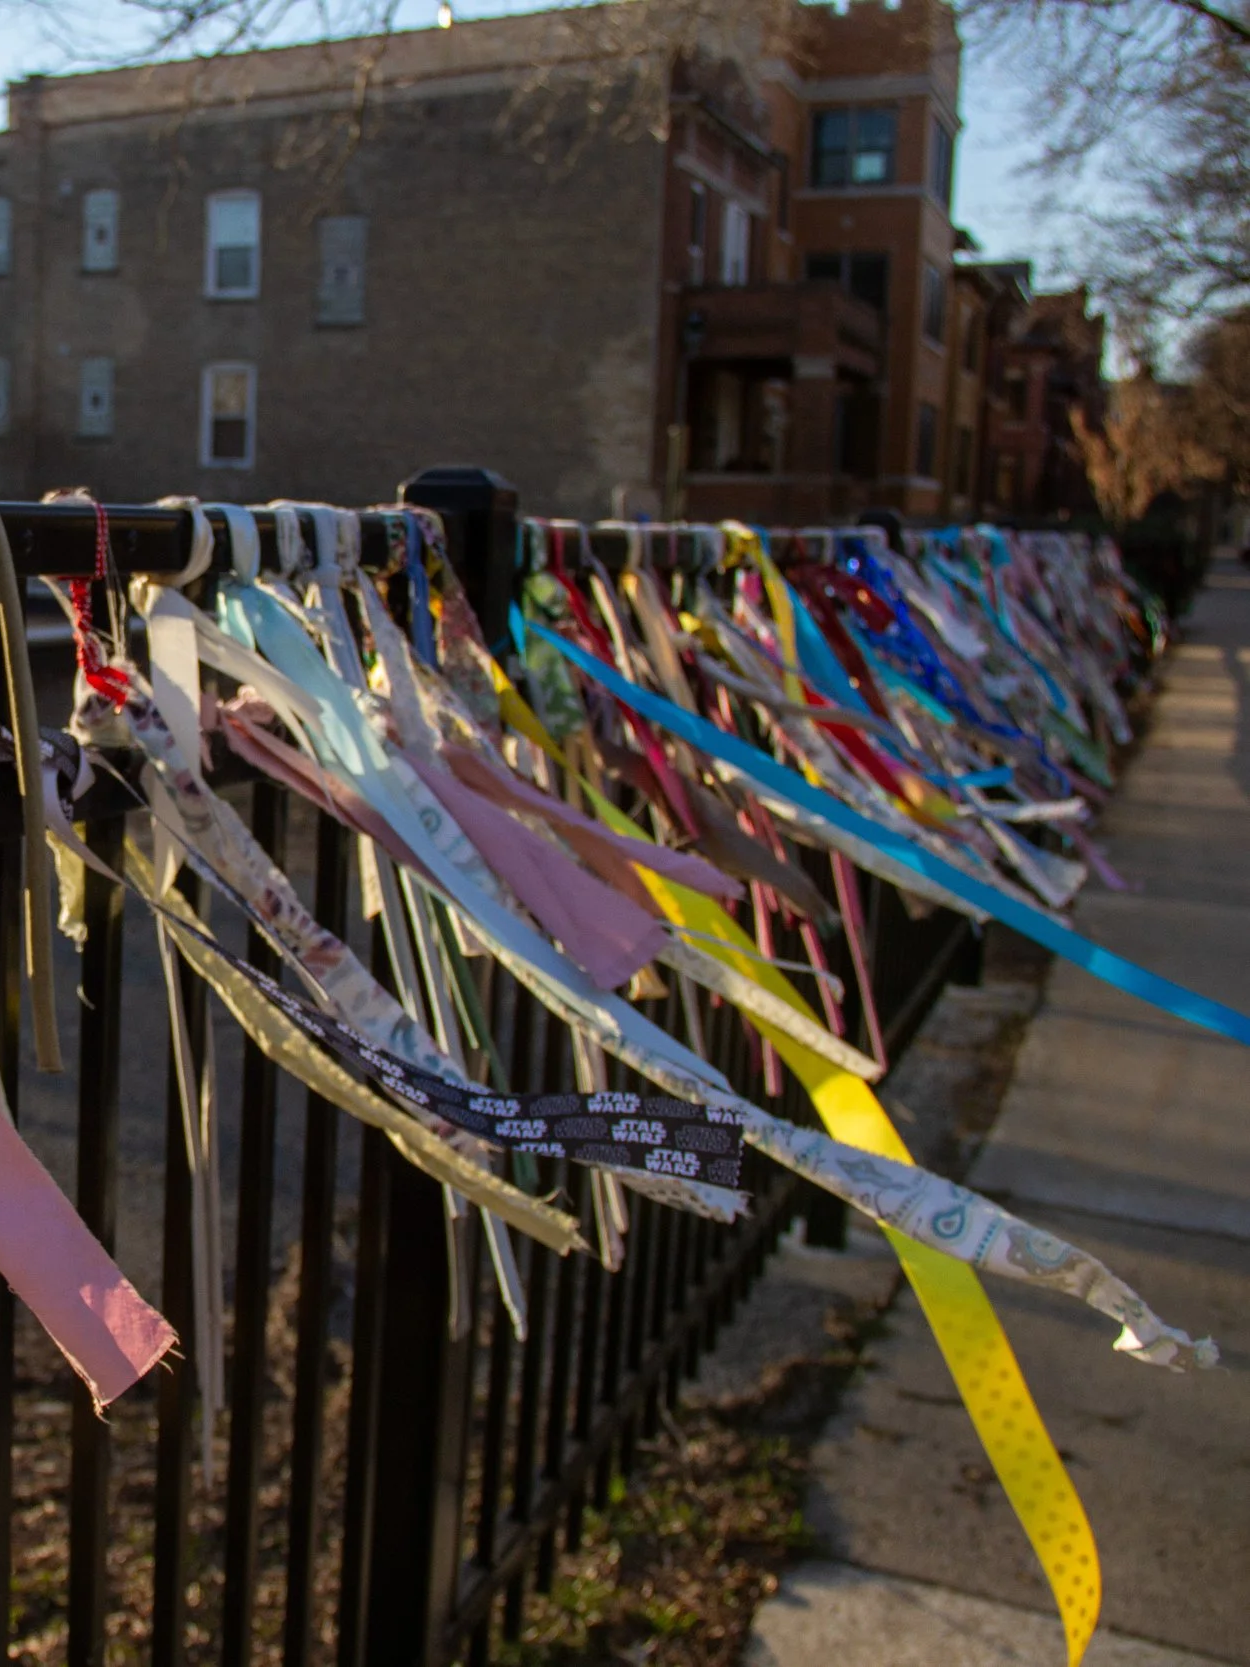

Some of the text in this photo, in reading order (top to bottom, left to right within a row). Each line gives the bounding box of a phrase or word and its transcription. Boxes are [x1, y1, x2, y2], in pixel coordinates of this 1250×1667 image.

[588, 1091, 639, 1103] STAR
[587, 1101, 641, 1114] WARS
[496, 1119, 546, 1130] STAR
[612, 1119, 664, 1133] STAR
[495, 1126, 548, 1139] WARS
[611, 1129, 667, 1145] WARS
[513, 1142, 564, 1156] STAR
[645, 1148, 699, 1164] STAR
[644, 1158, 701, 1177] WARS
